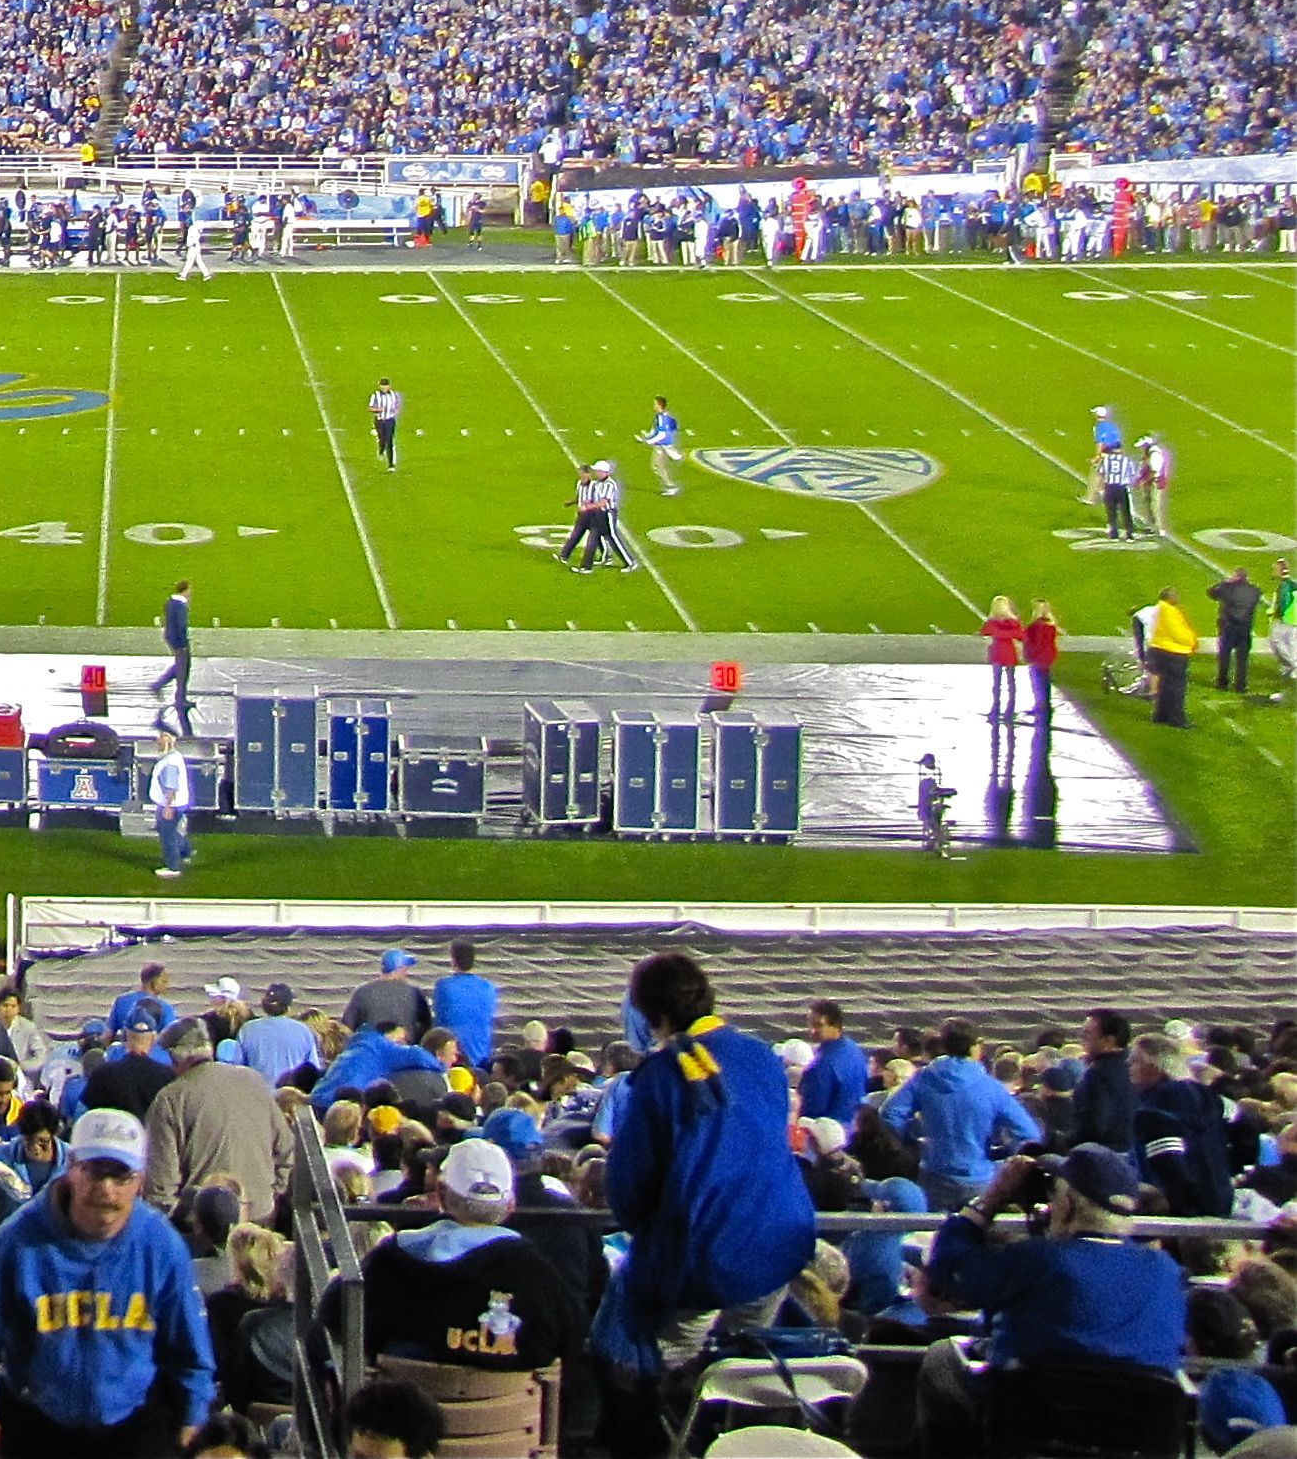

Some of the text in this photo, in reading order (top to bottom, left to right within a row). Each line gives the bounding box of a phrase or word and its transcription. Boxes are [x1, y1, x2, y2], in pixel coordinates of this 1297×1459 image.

[512, 524, 746, 550] 30
[83, 667, 104, 688] 40
[714, 666, 736, 687] 30
[70, 774, 98, 800] A
[35, 1292, 157, 1334] UCLA
[446, 1326, 519, 1356] UCLA
